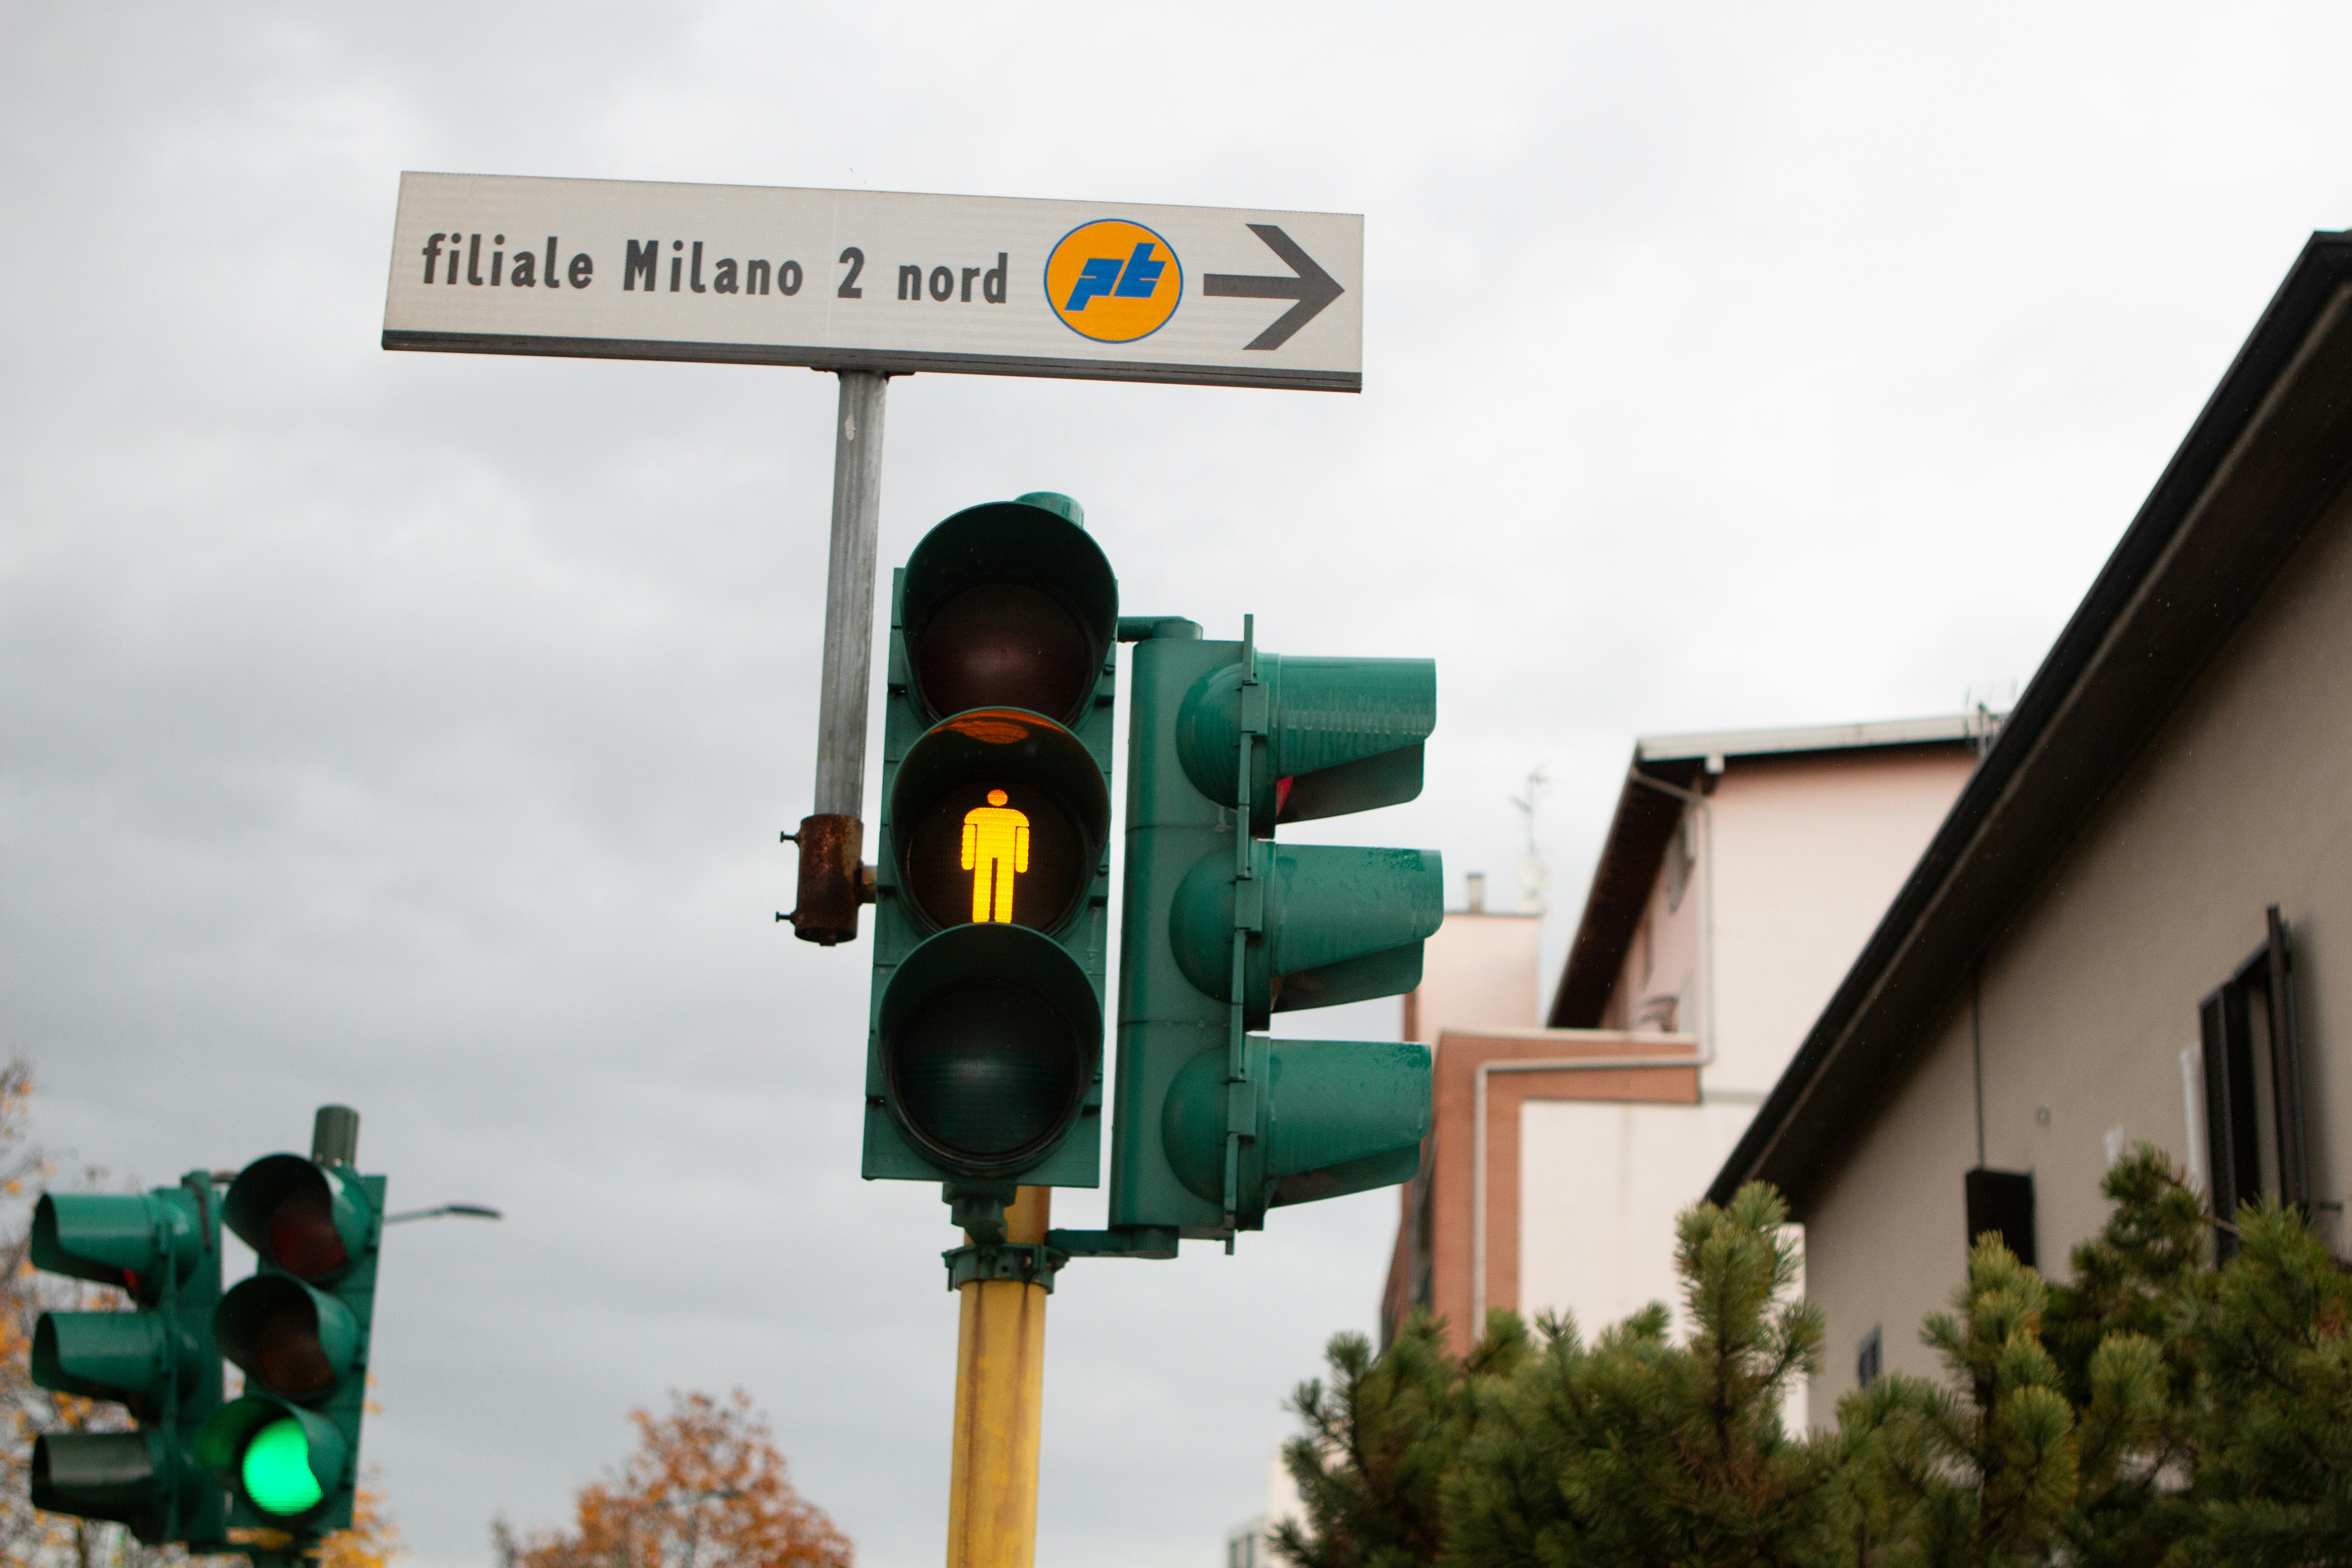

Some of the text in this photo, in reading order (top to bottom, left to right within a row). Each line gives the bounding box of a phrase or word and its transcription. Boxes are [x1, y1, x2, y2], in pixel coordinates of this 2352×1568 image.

[422, 233, 1008, 304] filiale Milano 2 nord
